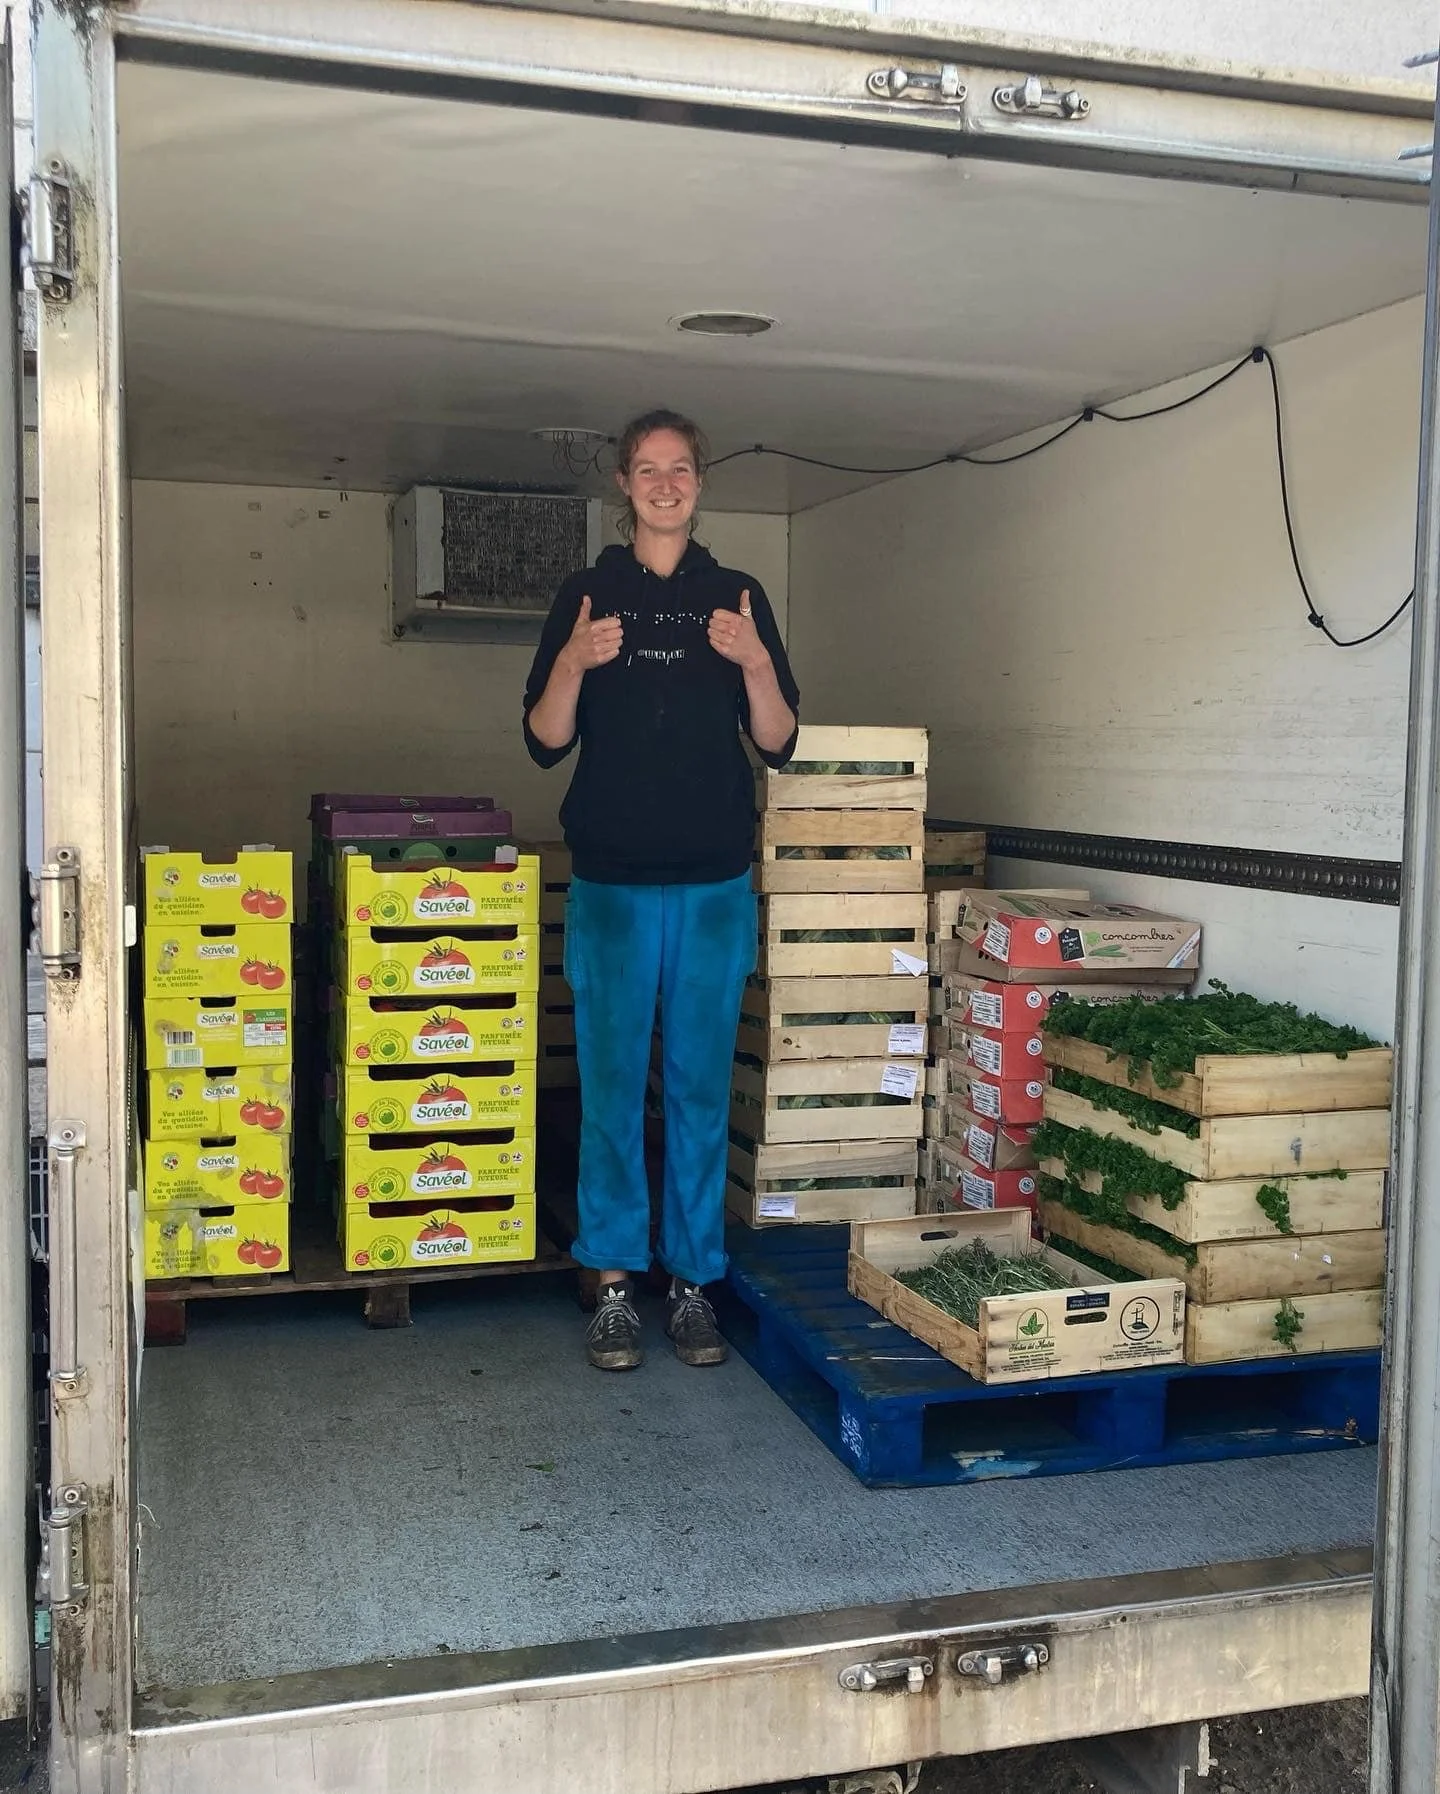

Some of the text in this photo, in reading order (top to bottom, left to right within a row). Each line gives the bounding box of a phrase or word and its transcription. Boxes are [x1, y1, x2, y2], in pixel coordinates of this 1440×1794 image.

[202, 873, 237, 884] Savéol
[419, 899, 470, 912] Savéol
[1102, 928, 1174, 940] concombres
[201, 945, 236, 955] Savéol
[420, 966, 470, 982] Savéol
[201, 1013, 236, 1023] Savéol
[419, 1034, 469, 1050] Savéol
[417, 1104, 467, 1118] Savéol
[201, 1156, 235, 1166] Savéol
[417, 1172, 467, 1187] Savéol
[417, 1240, 467, 1256] Savéol
